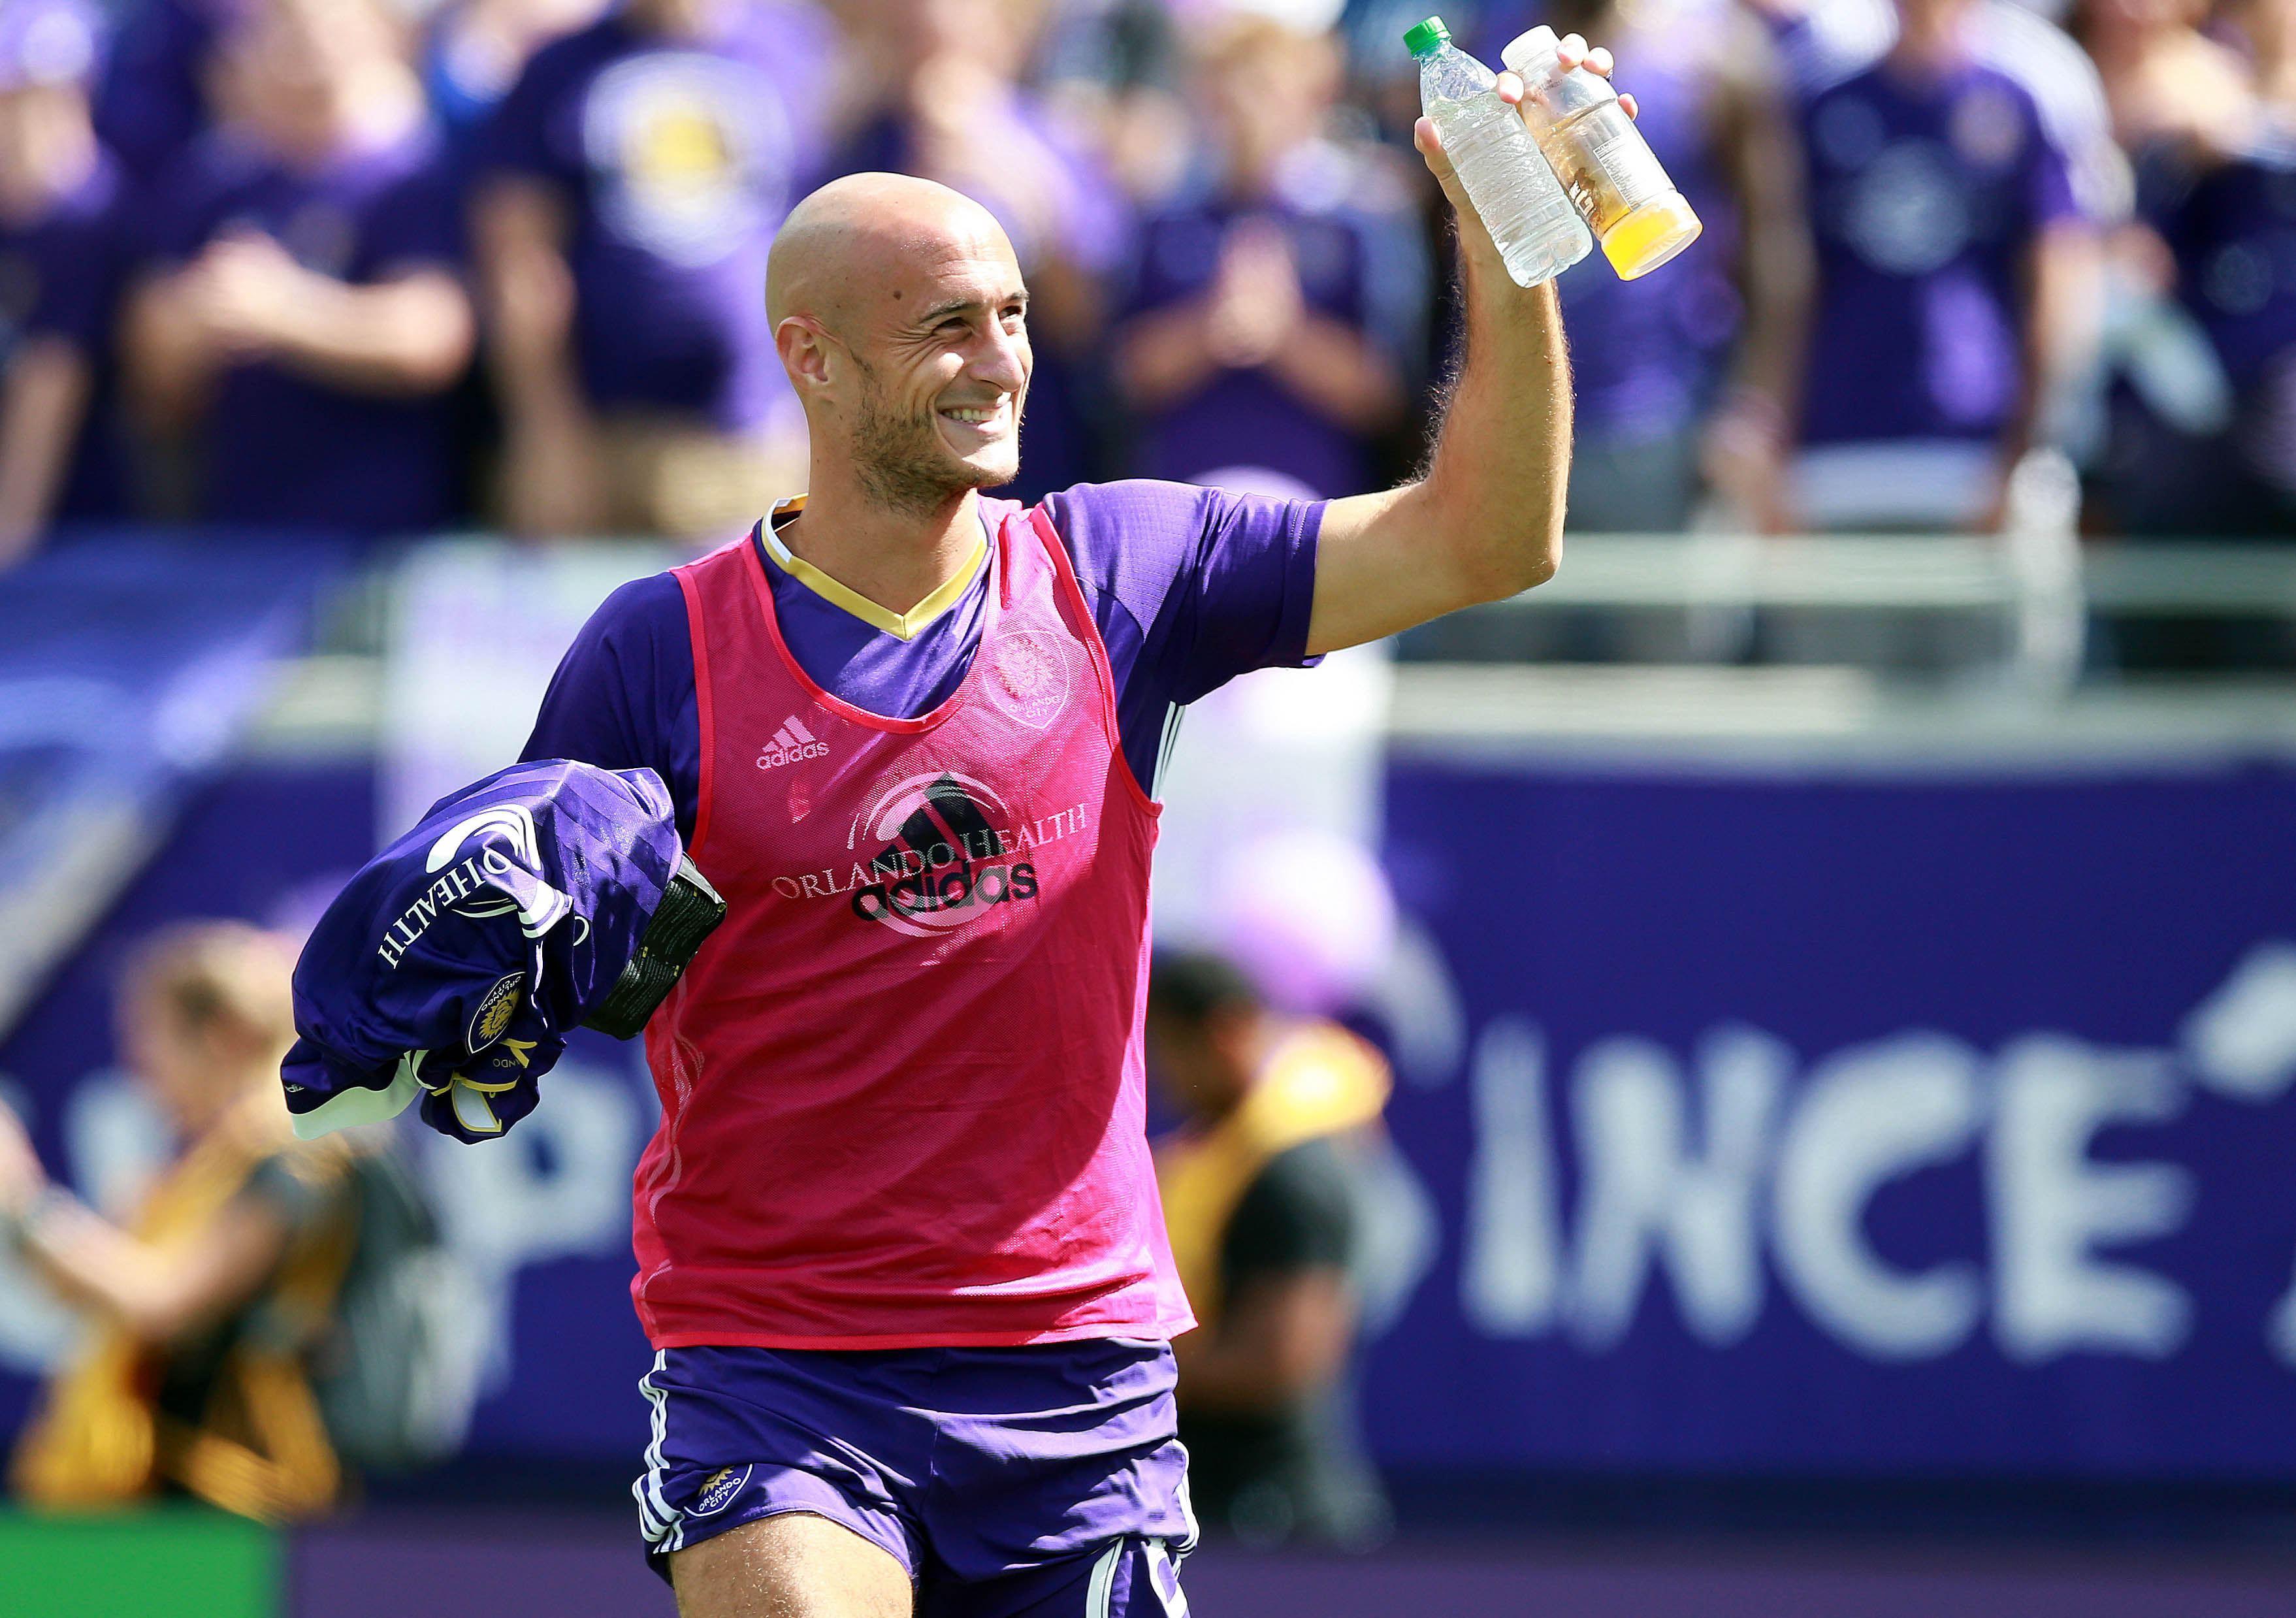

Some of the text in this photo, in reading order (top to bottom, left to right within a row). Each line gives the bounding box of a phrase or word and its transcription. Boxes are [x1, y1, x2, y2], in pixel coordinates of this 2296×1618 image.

[756, 742, 831, 769] adidas
[771, 803, 1088, 899] ORLANDO HEALTH
[851, 858, 1039, 922] adidas
[378, 856, 487, 969] HEALTH
[481, 975, 522, 1012] ORLANDO
[698, 1478, 741, 1512] ORLANDO
[709, 1489, 729, 1508] CITY
